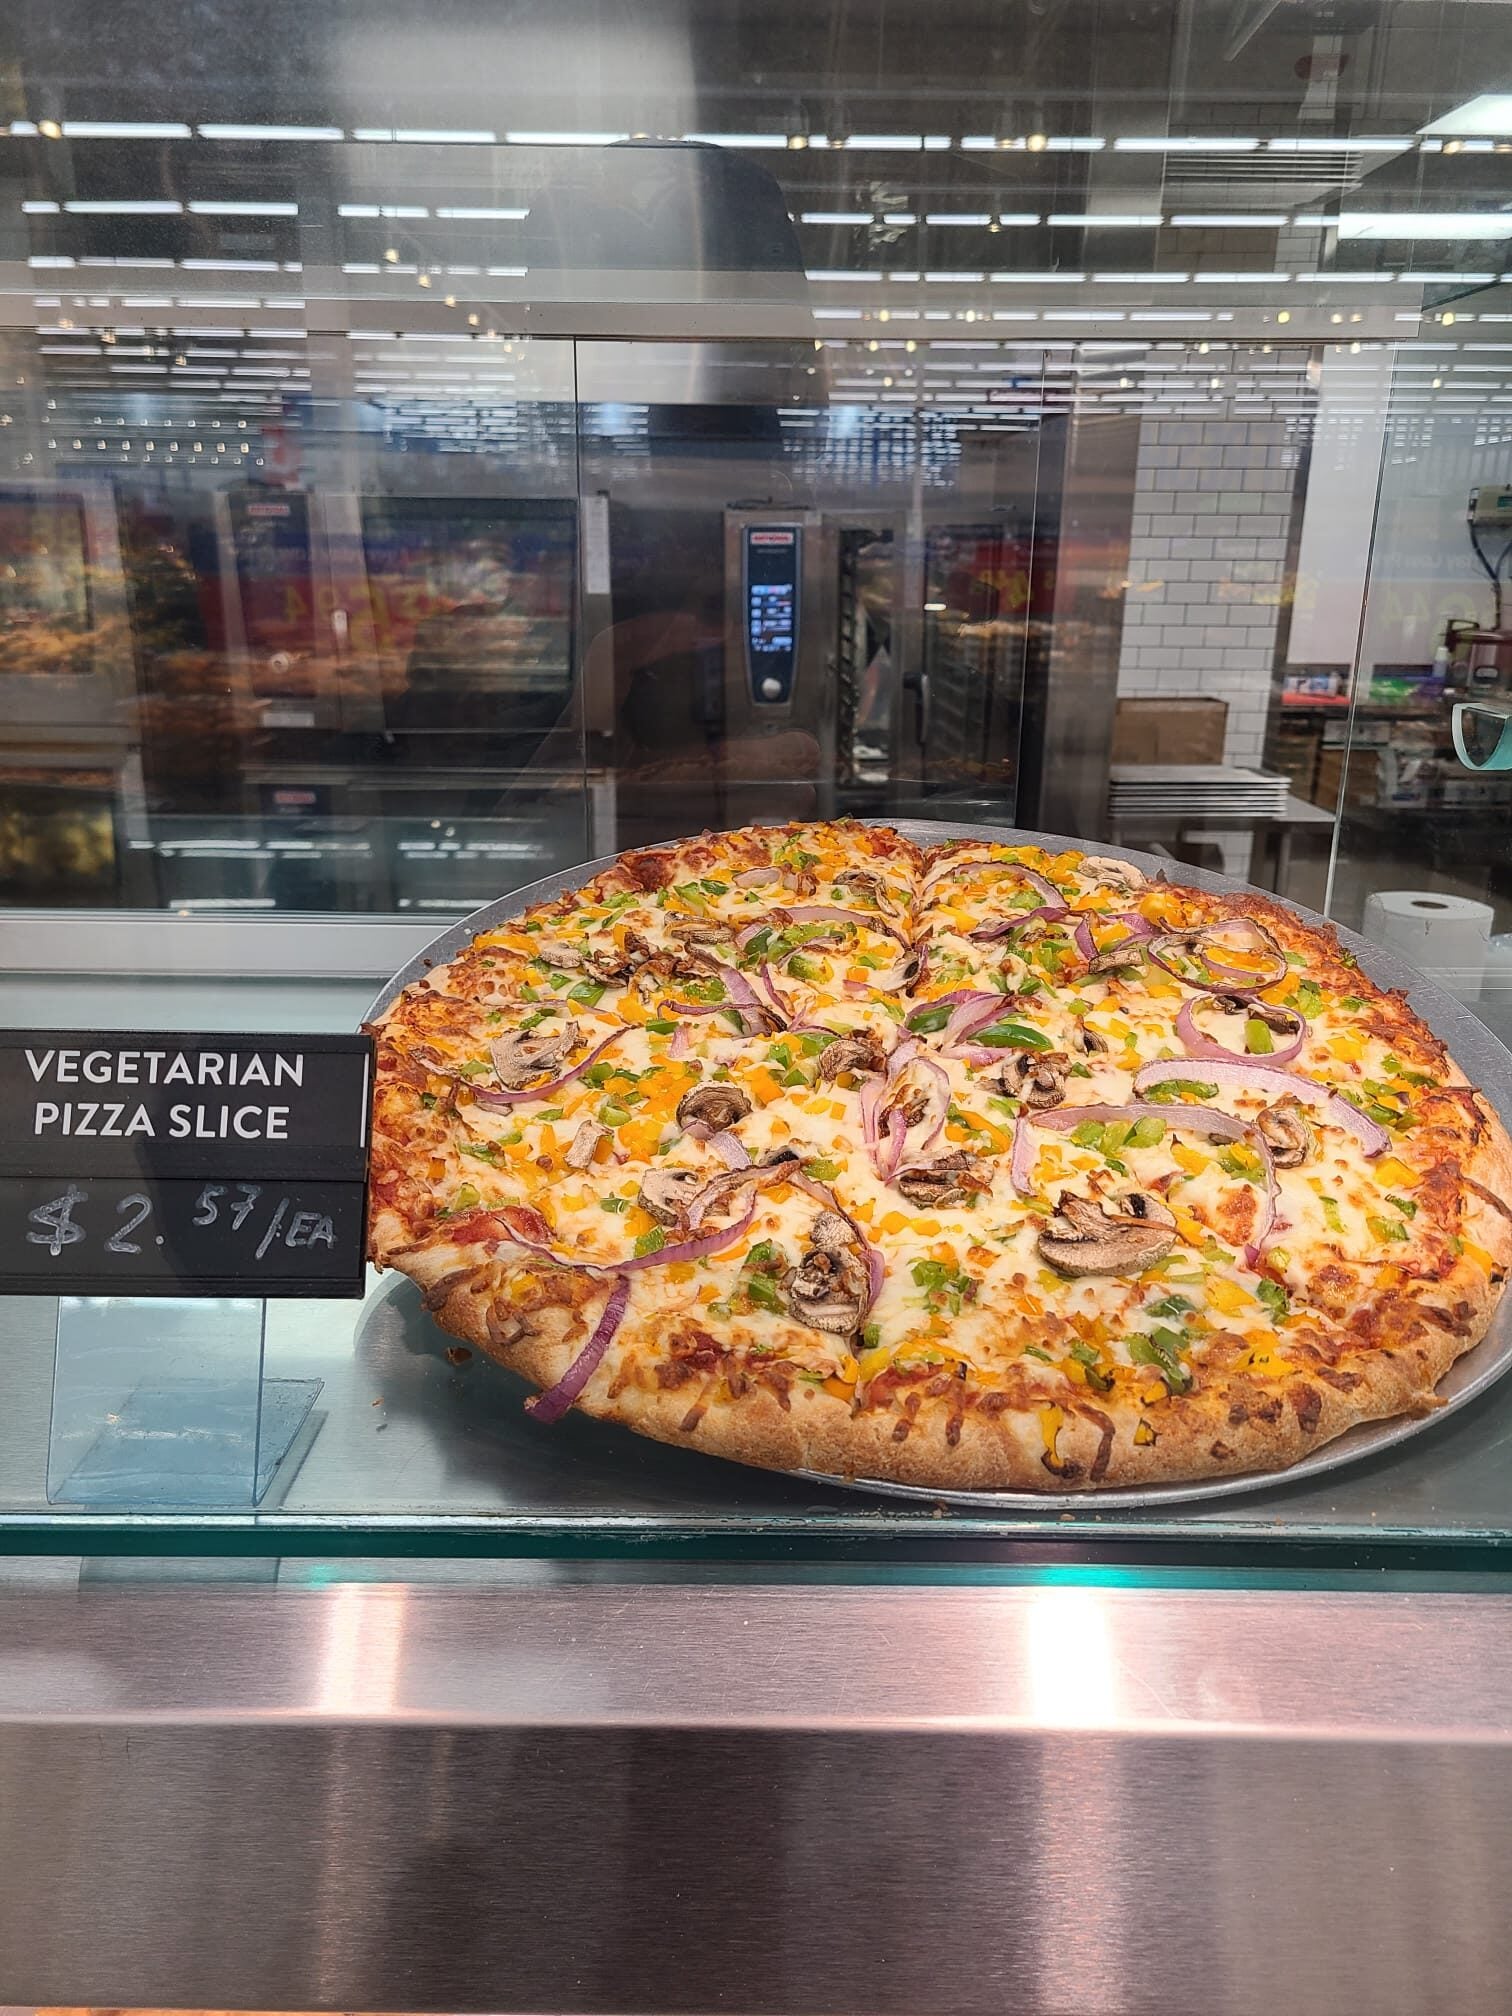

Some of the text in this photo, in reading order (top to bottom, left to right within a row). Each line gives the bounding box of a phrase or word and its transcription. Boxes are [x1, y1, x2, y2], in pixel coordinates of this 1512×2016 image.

[24, 1049, 304, 1087] VEGETARIAN
[34, 1102, 290, 1139] PIZZA SLICE
